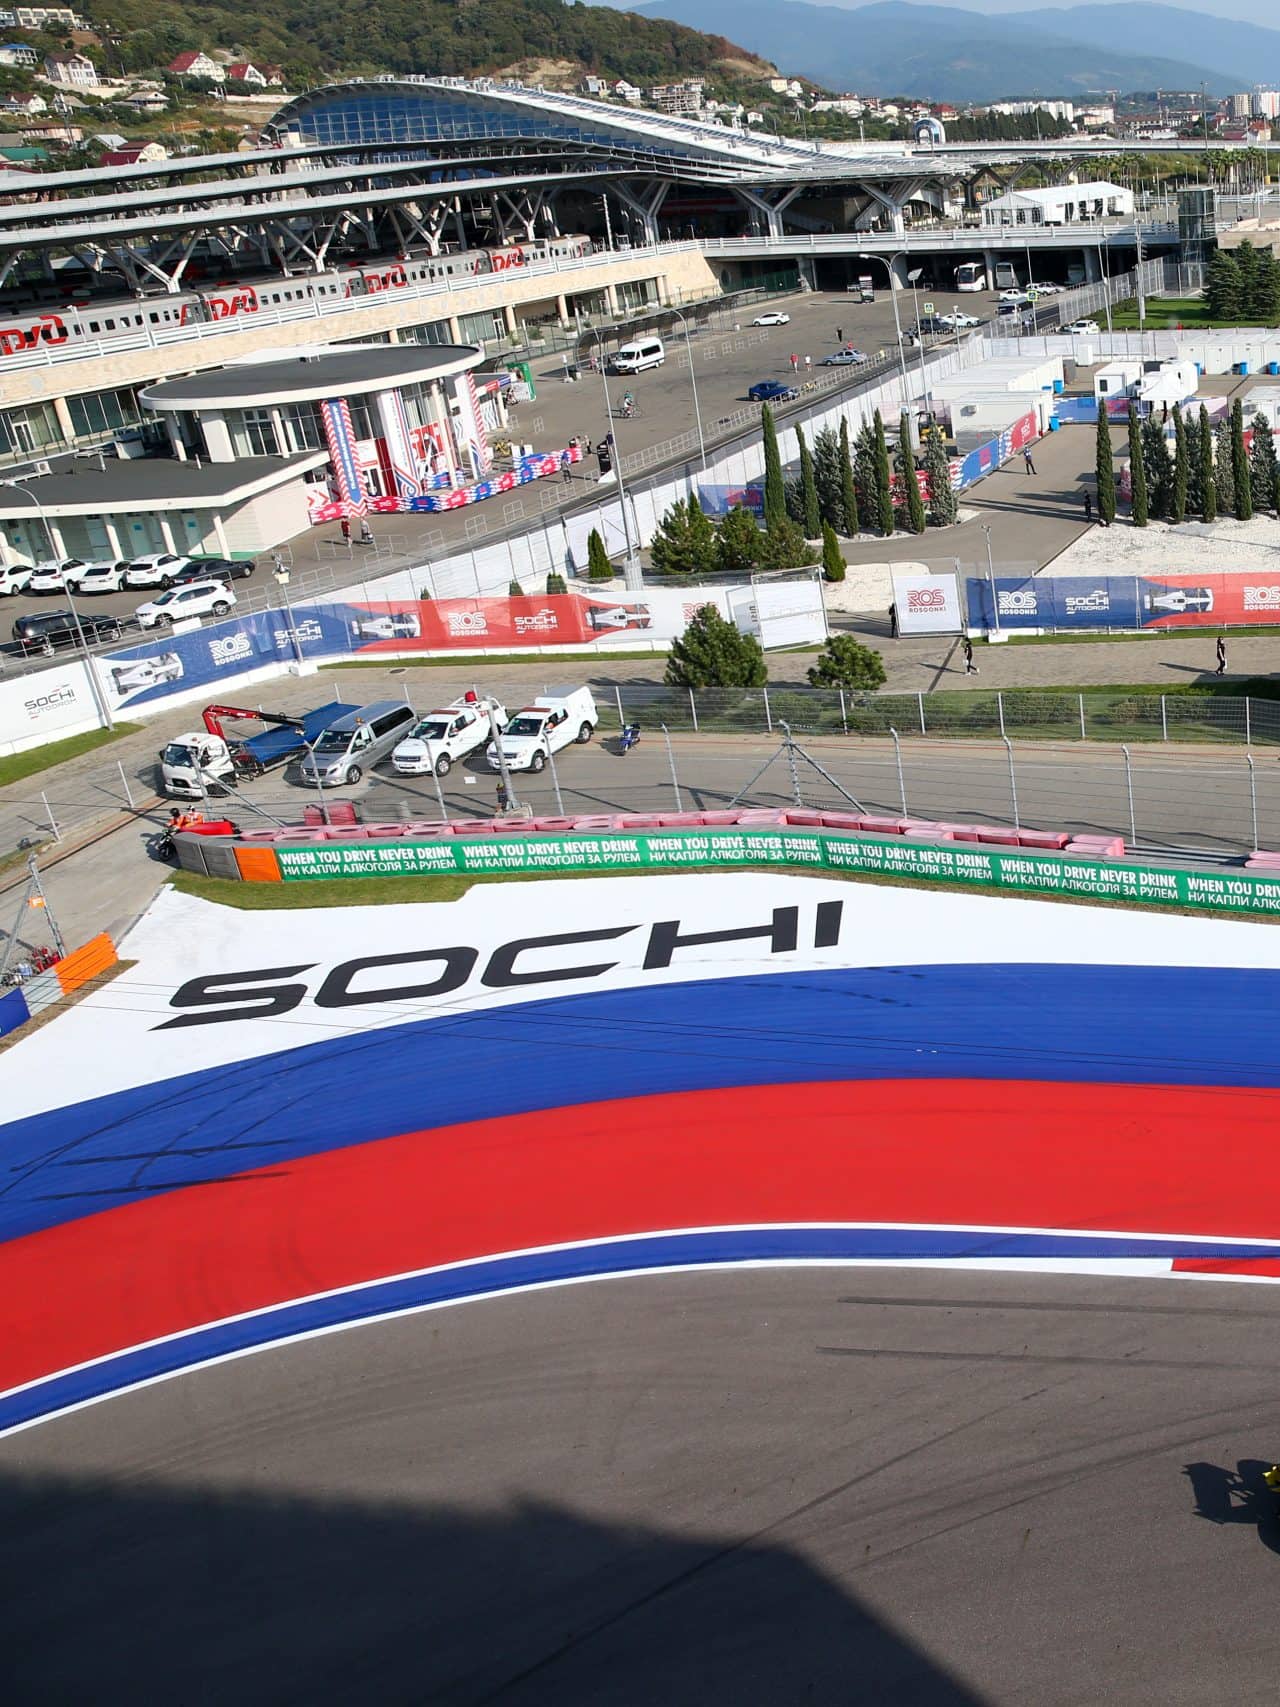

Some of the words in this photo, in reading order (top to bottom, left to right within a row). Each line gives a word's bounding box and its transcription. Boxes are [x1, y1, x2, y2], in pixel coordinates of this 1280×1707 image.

[907, 589, 945, 607] ROS
[998, 591, 1037, 609] ROS
[1065, 597, 1109, 606] SOCHI
[449, 612, 486, 629] ROS
[514, 615, 557, 626] SOCHI
[208, 632, 250, 658] ROS
[24, 689, 75, 711] SOCHI
[462, 845, 498, 857] WHEN
[499, 844, 524, 856] YOU
[526, 843, 561, 854] DRIVE
[562, 841, 599, 856] NEVER
[600, 840, 638, 854] DRINK
[647, 839, 682, 850] WHEN
[684, 838, 708, 852] YOU
[711, 838, 745, 852] DRIVE
[746, 838, 782, 852] NEVER
[783, 838, 818, 852] DRINK
[279, 852, 315, 864] WHEN
[316, 851, 341, 863] YOU
[343, 850, 376, 862] DRIVE
[378, 848, 415, 860] NEVER
[416, 846, 453, 859] DRINK
[465, 858, 483, 868] НИ
[484, 857, 524, 867] КАПЛИ
[526, 855, 585, 865] АЛКОГОЛЯ
[587, 854, 602, 864] ЗА
[602, 853, 640, 862] РУЛЕМ
[649, 851, 666, 861] НИ
[667, 851, 708, 861] КАПЛИ
[710, 851, 767, 859] АЛКОГОЛЯ
[769, 851, 784, 860] ЗА
[785, 851, 821, 861] РУЛЕМ
[826, 842, 859, 855] WHEN
[860, 844, 882, 858] YOU
[885, 847, 916, 861] DRIVE
[919, 851, 953, 864] NEVER
[955, 854, 990, 868] DRINK
[283, 864, 299, 875] НИ
[301, 864, 340, 874] КАПЛИ
[343, 861, 401, 872] АЛКОГОЛЯ
[403, 860, 417, 870] ЗА
[419, 859, 456, 869] РУЛЕМ
[828, 854, 843, 864] НИ
[845, 856, 881, 868] КАПЛИ
[883, 860, 939, 874] АЛКОГОЛЯ
[941, 865, 954, 875] ЗА
[956, 867, 992, 879] РУЛЕМ
[1000, 859, 1034, 873] WHEN
[1036, 863, 1060, 876] YOU
[1064, 865, 1096, 880] DRIVE
[1100, 869, 1136, 884] NEVER
[1139, 873, 1176, 887] DRINK
[1001, 873, 1018, 883] НИ
[1020, 874, 1058, 887] КАПЛИ
[1061, 879, 1120, 893] АЛКОГОЛЯ
[1123, 884, 1137, 895] ЗА
[1139, 886, 1178, 898] РУЛЕМ
[1187, 877, 1223, 892] WHEN
[1226, 881, 1251, 895] YOU
[1187, 891, 1205, 902] НИ
[1207, 893, 1249, 905] КАПЛИ
[148, 900, 843, 1031] SOCHI
